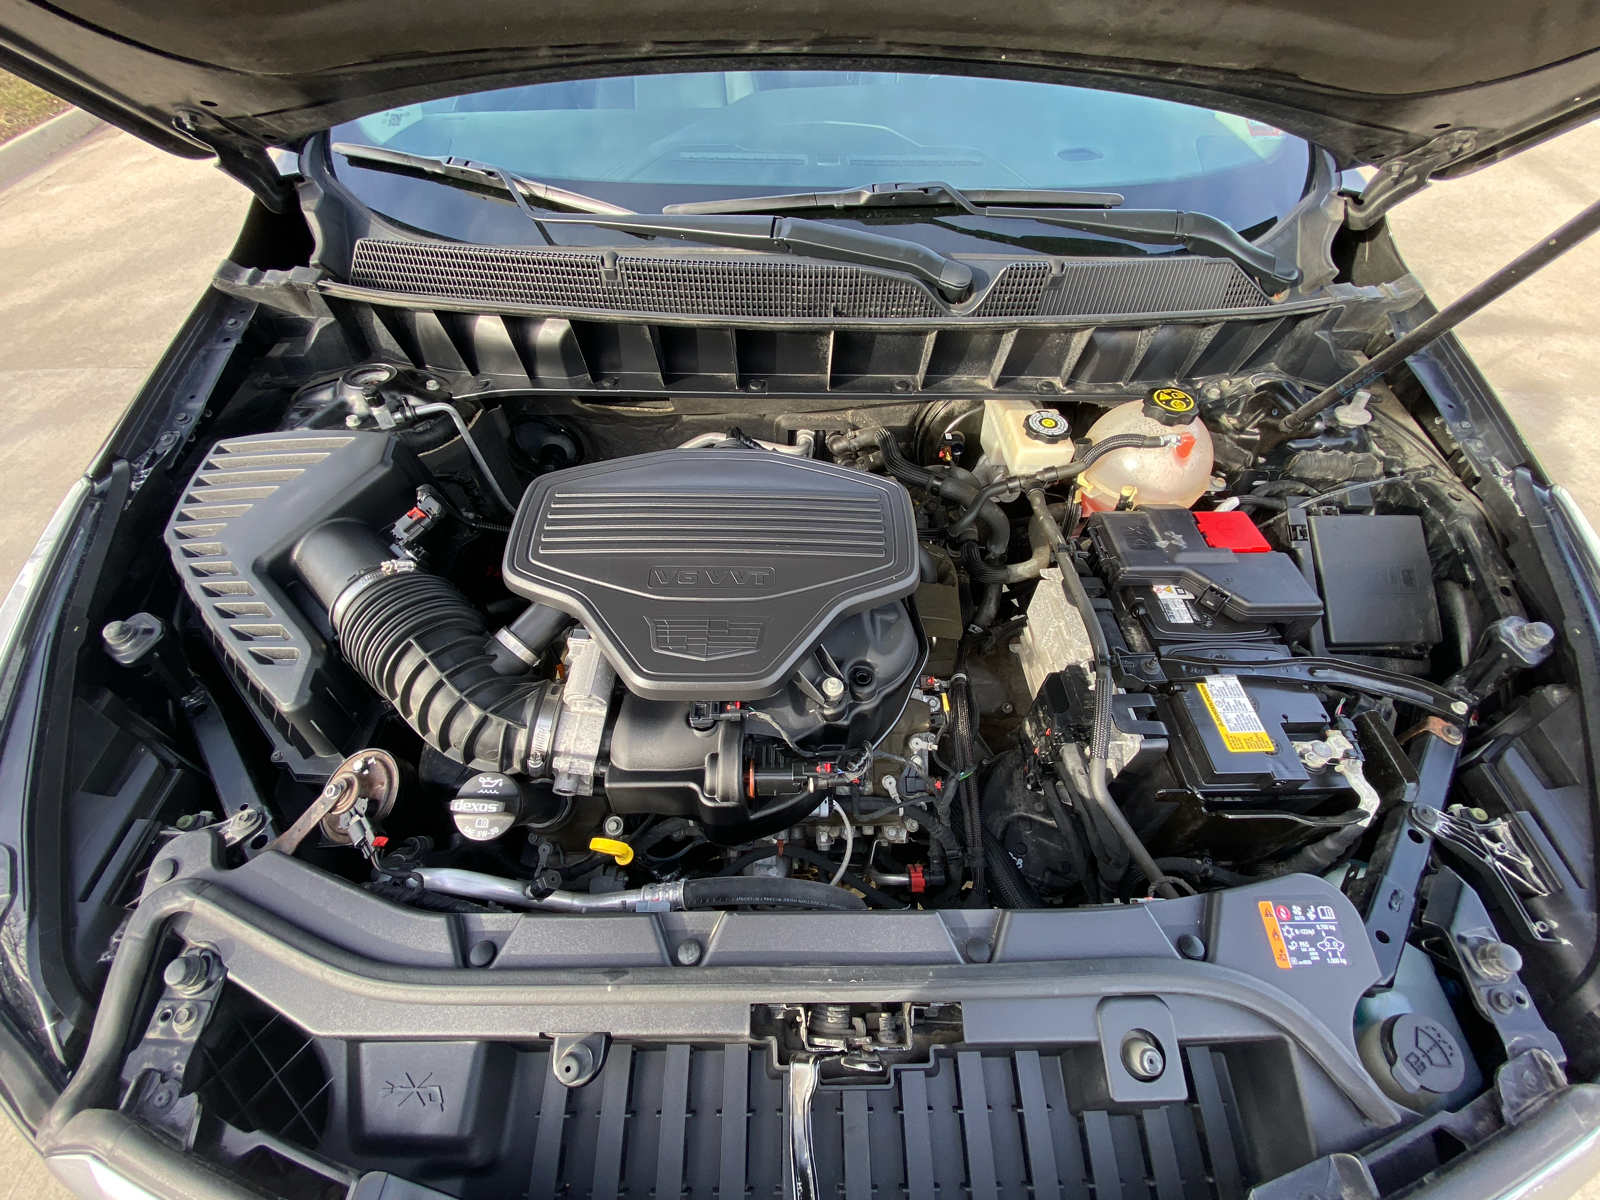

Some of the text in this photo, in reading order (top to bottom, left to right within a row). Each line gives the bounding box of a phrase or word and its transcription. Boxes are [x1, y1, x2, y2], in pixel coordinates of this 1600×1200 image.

[654, 570, 770, 586] V6 VVT
[454, 800, 499, 812] dexos
[463, 825, 499, 837] SAE 5W-30
